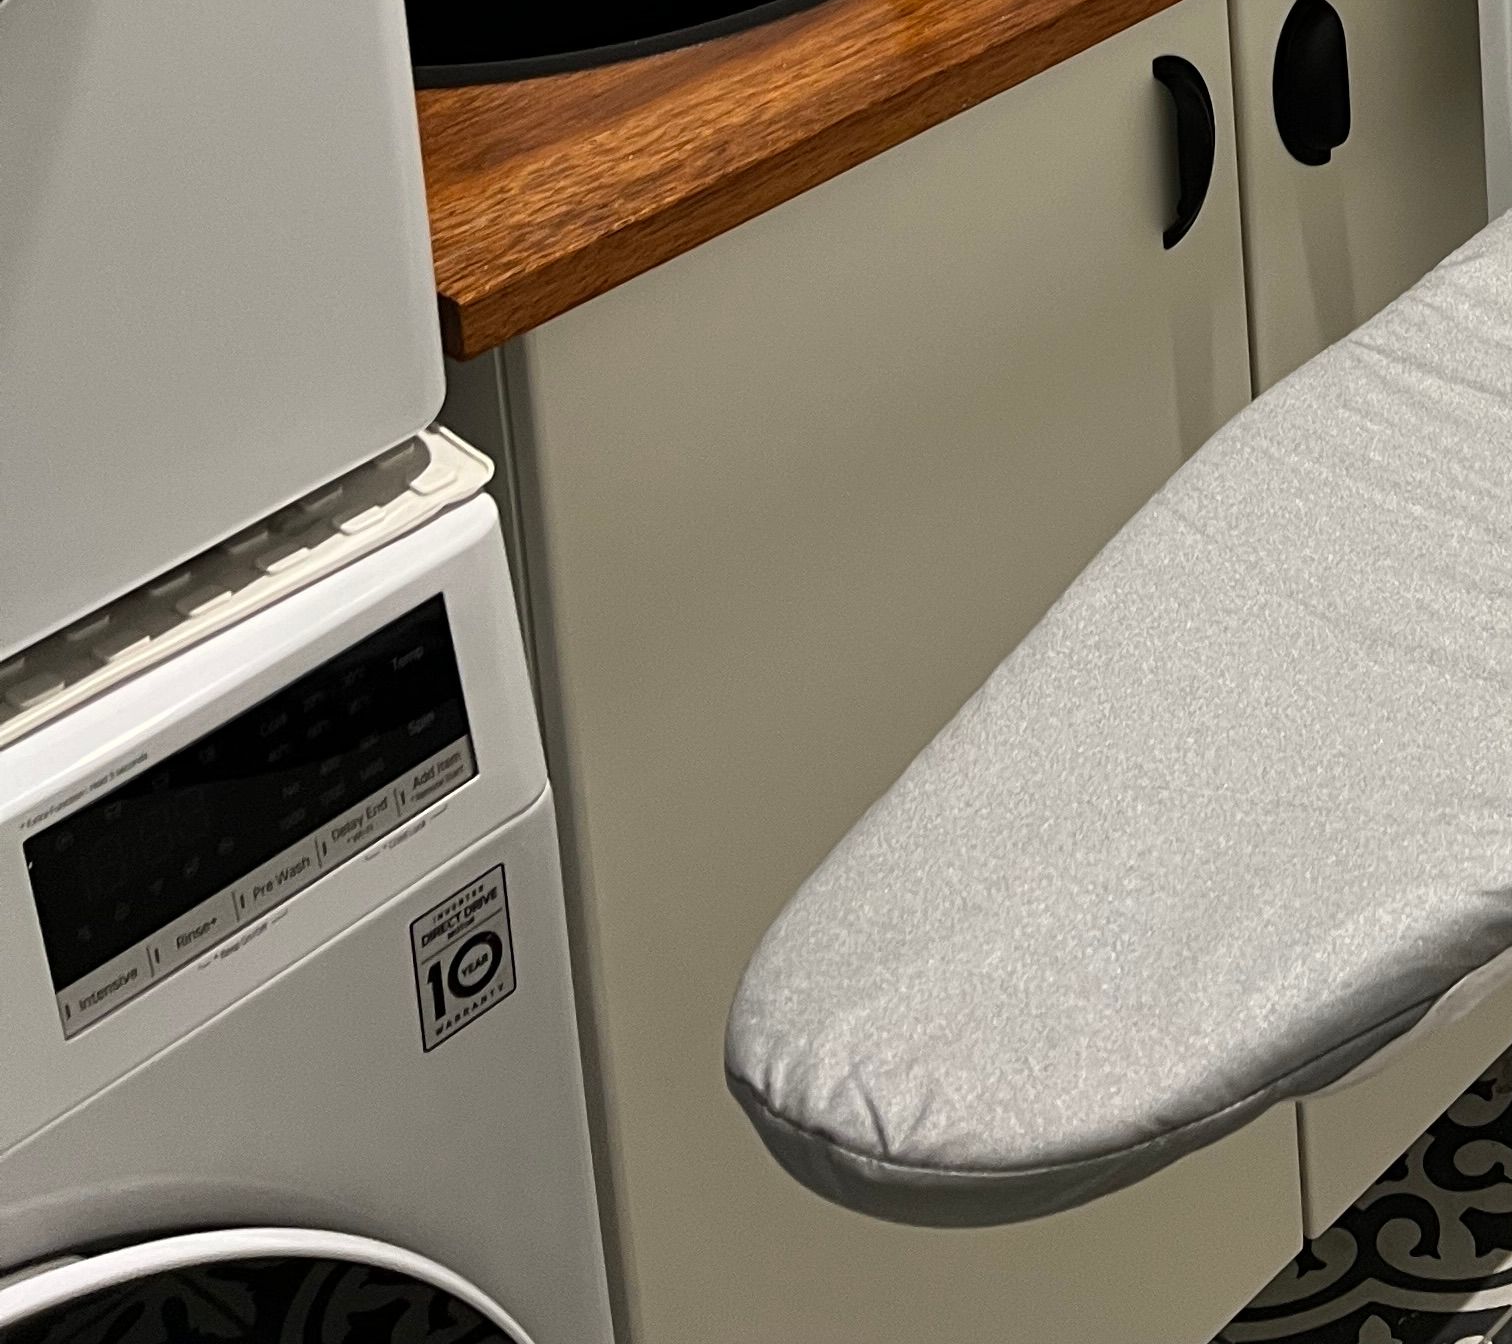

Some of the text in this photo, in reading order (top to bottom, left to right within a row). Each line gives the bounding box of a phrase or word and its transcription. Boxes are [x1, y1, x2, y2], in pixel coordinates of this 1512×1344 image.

[365, 796, 388, 822] End
[253, 855, 311, 901] Pre Wash
[421, 886, 498, 948] DIRECT DRIVE
[427, 930, 503, 1021] 10
[461, 952, 489, 978] YEAR
[79, 968, 138, 1011] Intensive
[435, 981, 504, 1036] WARRANTY
